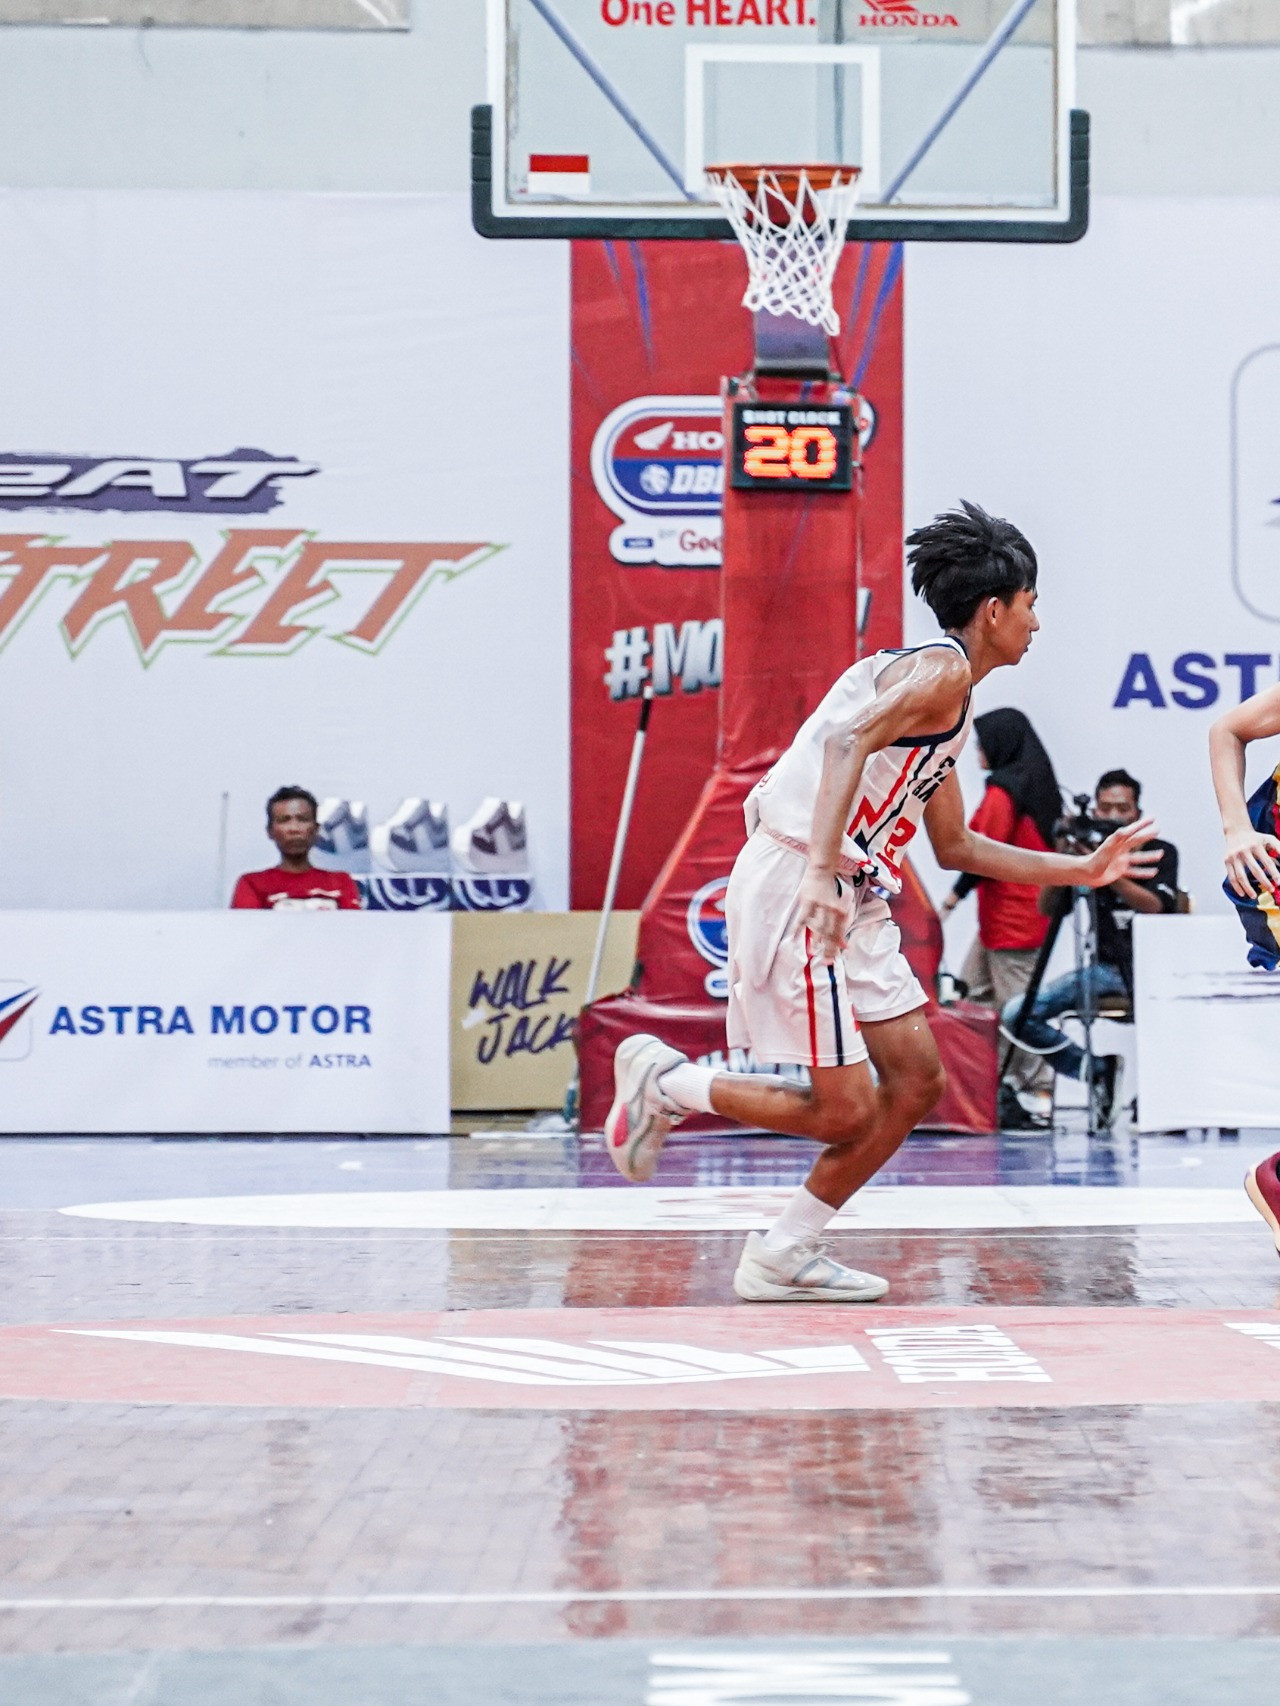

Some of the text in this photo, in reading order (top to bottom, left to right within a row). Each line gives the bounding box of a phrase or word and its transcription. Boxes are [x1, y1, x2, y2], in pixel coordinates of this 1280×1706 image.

[601, 0, 675, 27] One
[858, 14, 960, 28] HONDA
[671, 430, 724, 450] HO
[744, 426, 837, 478] 20
[669, 464, 724, 495] DB
[468, 956, 571, 1010] WALK
[49, 1004, 372, 1035] ASTRA MOTOR
[477, 1013, 578, 1065] JACK
[208, 1054, 372, 1069] member of ASTRA
[864, 1324, 1054, 1384] HONDA
